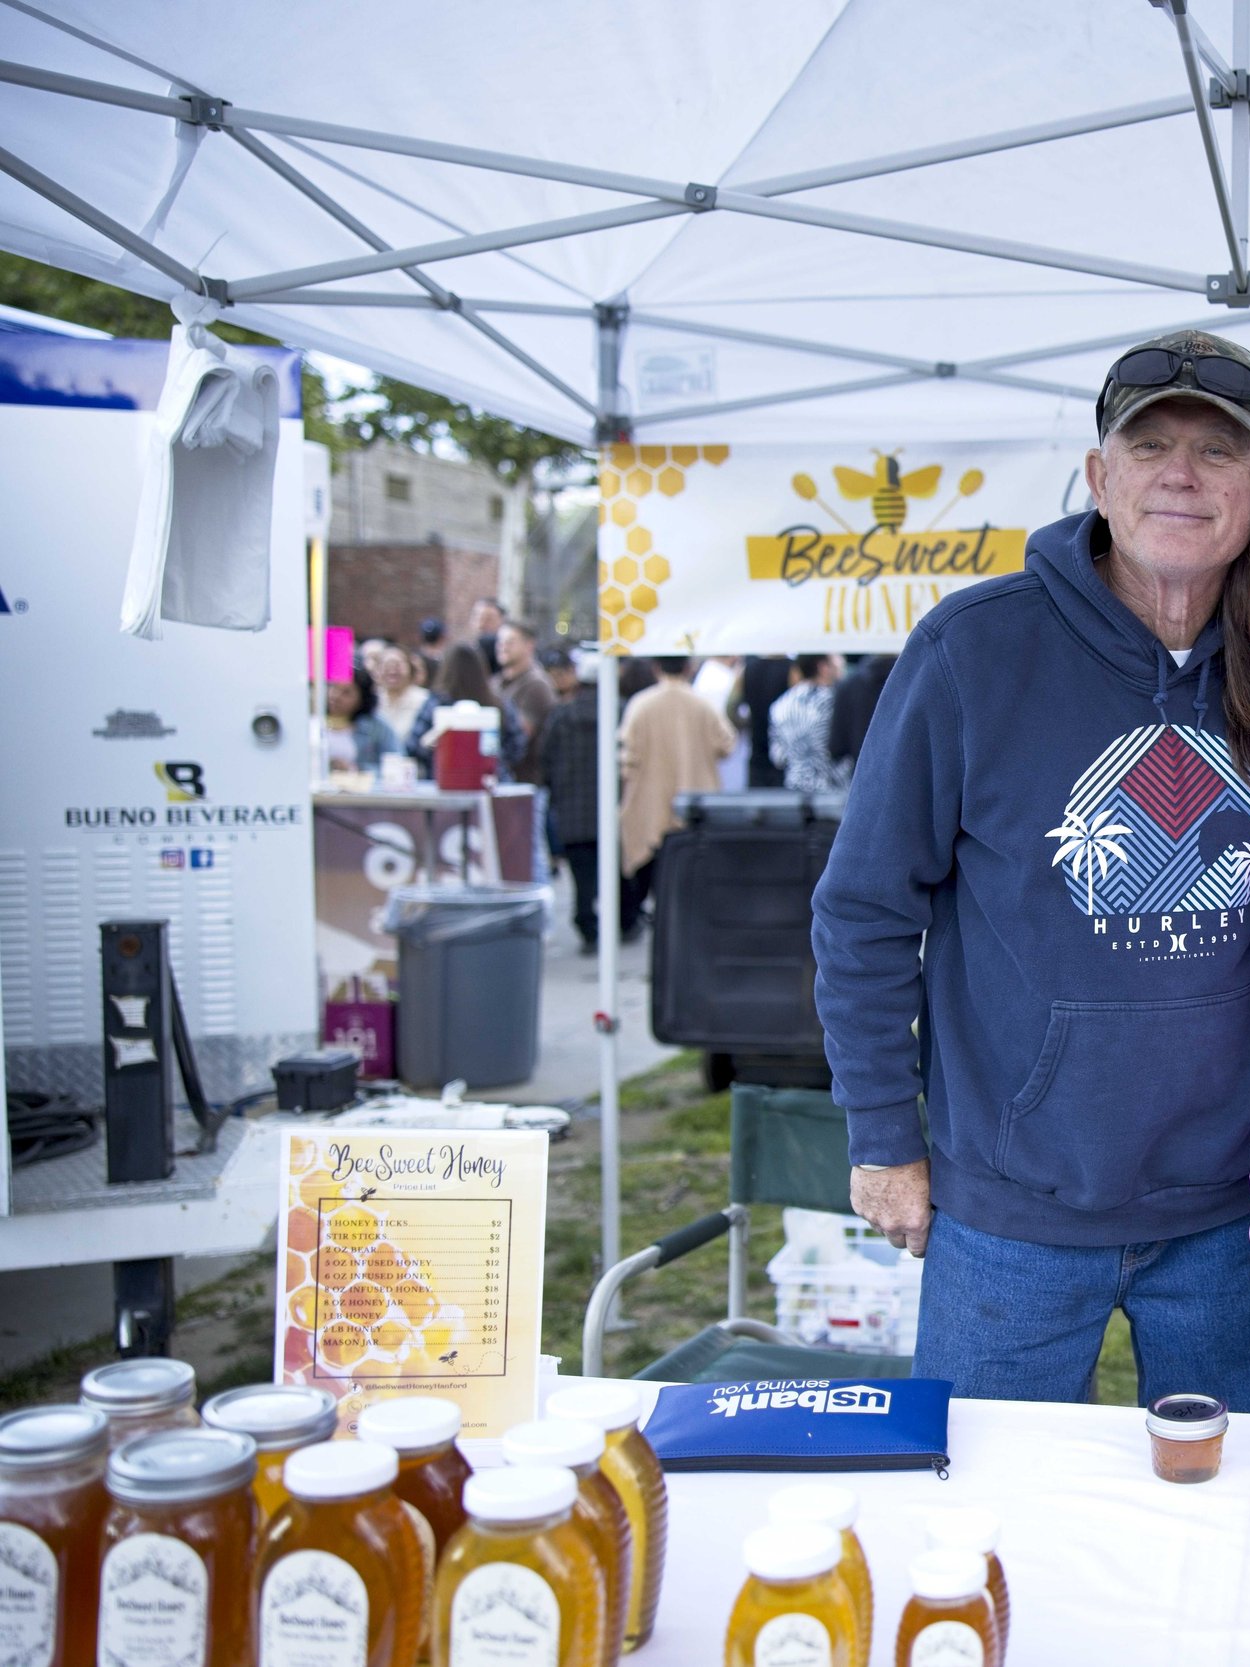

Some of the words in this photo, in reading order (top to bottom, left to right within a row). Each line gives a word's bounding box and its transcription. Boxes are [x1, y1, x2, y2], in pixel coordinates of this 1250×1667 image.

[778, 520, 1000, 587] BeeSweet
[65, 806, 156, 828] BUENO
[166, 804, 303, 827] BEVERAGE
[1094, 908, 1245, 934] HURLEY
[1112, 939, 1160, 950] ESTD
[1199, 932, 1238, 945] 1999
[329, 1144, 436, 1182] BeeSweet
[440, 1144, 507, 1188] Honey
[335, 1219, 371, 1227] HONEY
[373, 1219, 409, 1227] STICKS
[491, 1219, 502, 1227] $2
[333, 1246, 348, 1254] OZ
[351, 1246, 377, 1254] BEAR
[332, 1259, 348, 1267] OZ
[350, 1259, 394, 1267] INFUSED
[396, 1259, 432, 1267] HONEY
[485, 1259, 500, 1267] $12
[332, 1272, 348, 1280] OZ
[350, 1272, 394, 1280] INFUSED
[396, 1272, 432, 1280] HONEY
[485, 1272, 500, 1280] $14
[331, 1299, 346, 1307] OZ
[349, 1299, 384, 1307] HONEY
[386, 1299, 404, 1307] JAR
[346, 1325, 383, 1333] HONEY
[482, 1324, 498, 1332] $25
[323, 1338, 360, 1347] MASON
[361, 1338, 379, 1347] JAR
[481, 1337, 497, 1345] $35
[713, 1383, 750, 1397] you
[756, 1380, 830, 1393] serving
